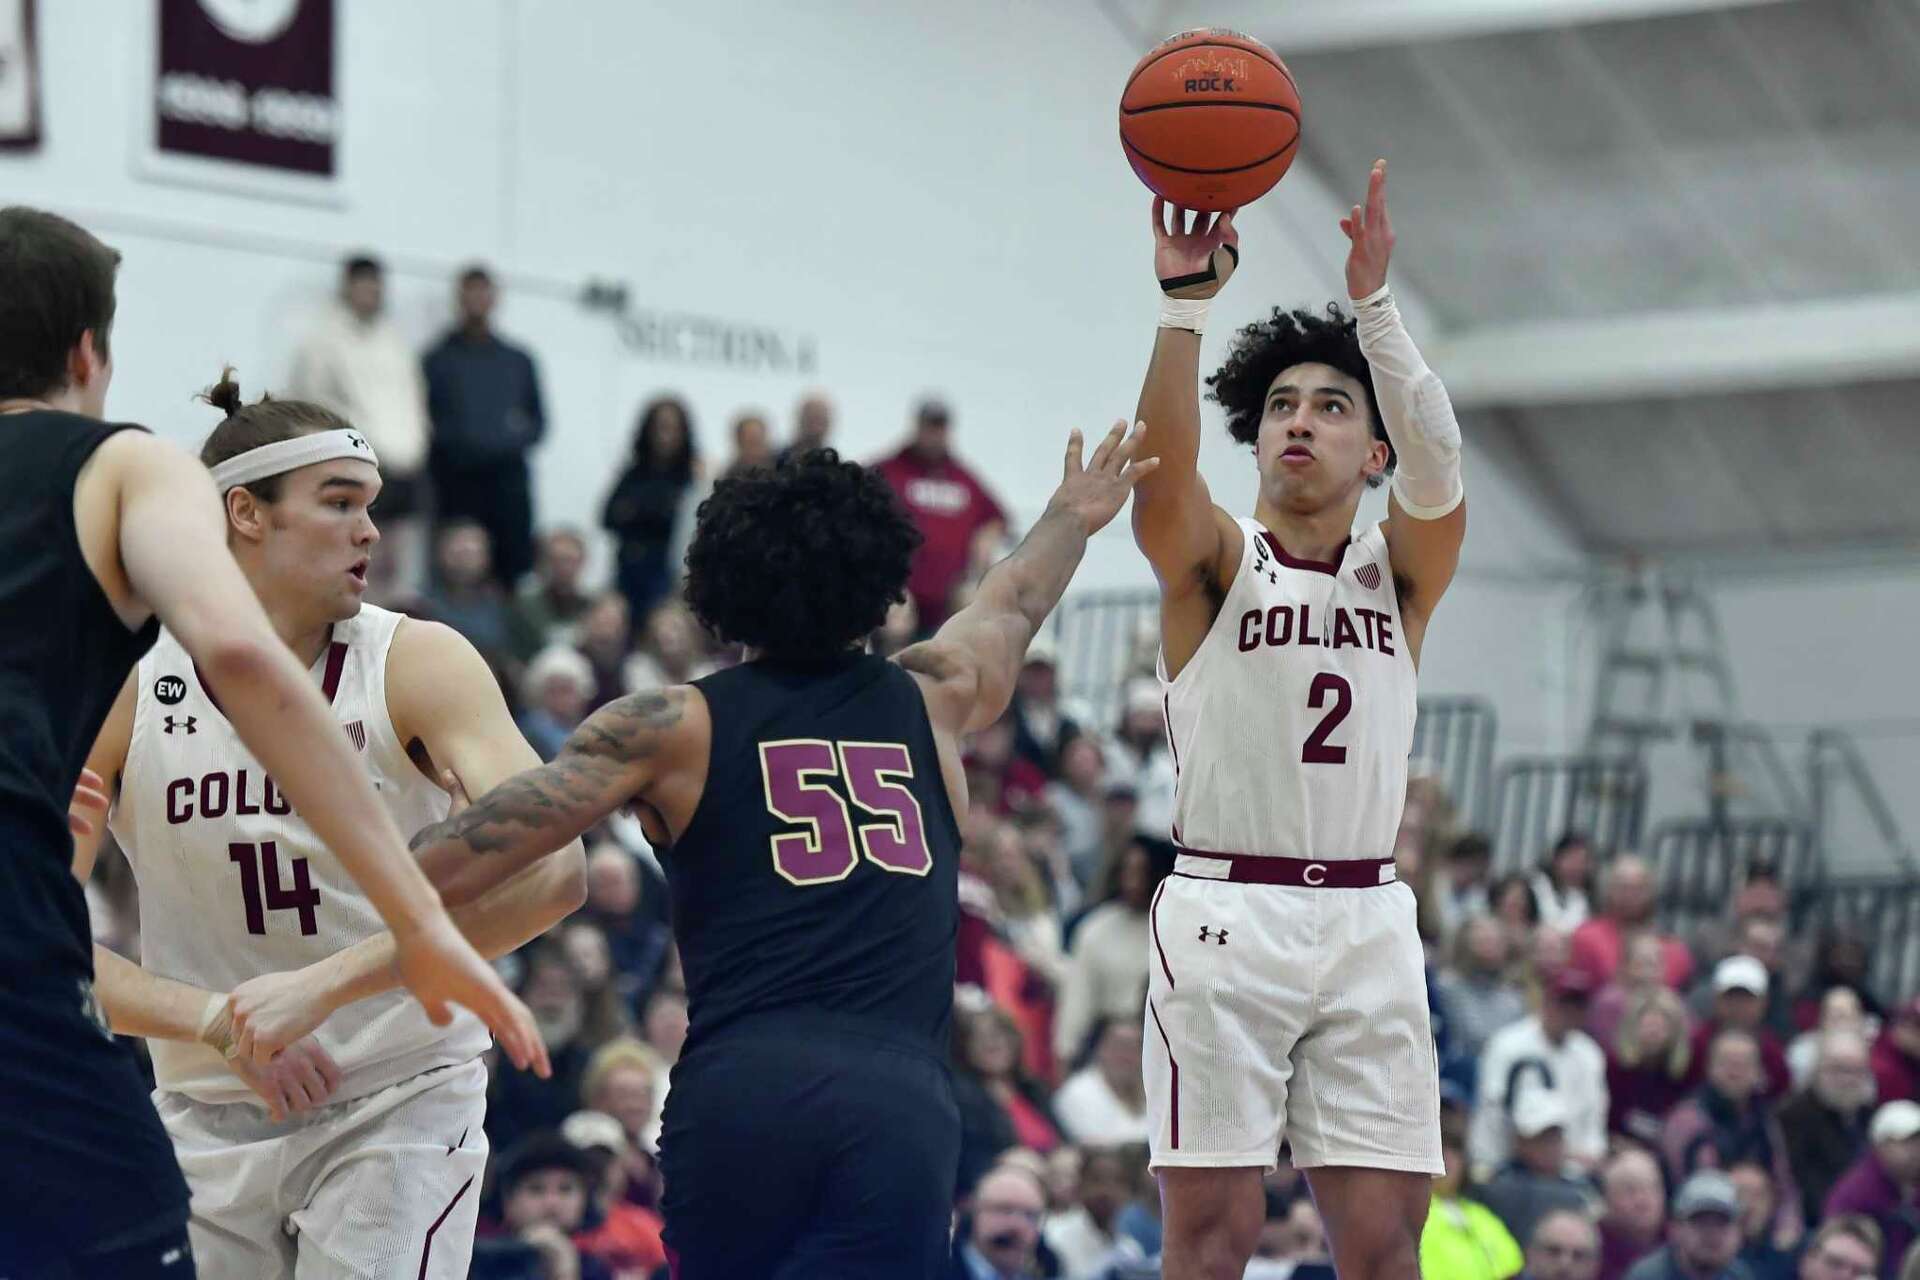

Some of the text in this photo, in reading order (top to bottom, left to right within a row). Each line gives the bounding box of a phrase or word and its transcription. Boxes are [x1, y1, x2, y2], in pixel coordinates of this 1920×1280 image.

[1184, 79, 1234, 93] ROCK
[156, 681, 184, 699] EW
[1301, 672, 1352, 764] 2
[166, 769, 296, 825] COLG
[758, 738, 934, 886] 55
[228, 841, 321, 936] 14
[1302, 863, 1328, 886] C
